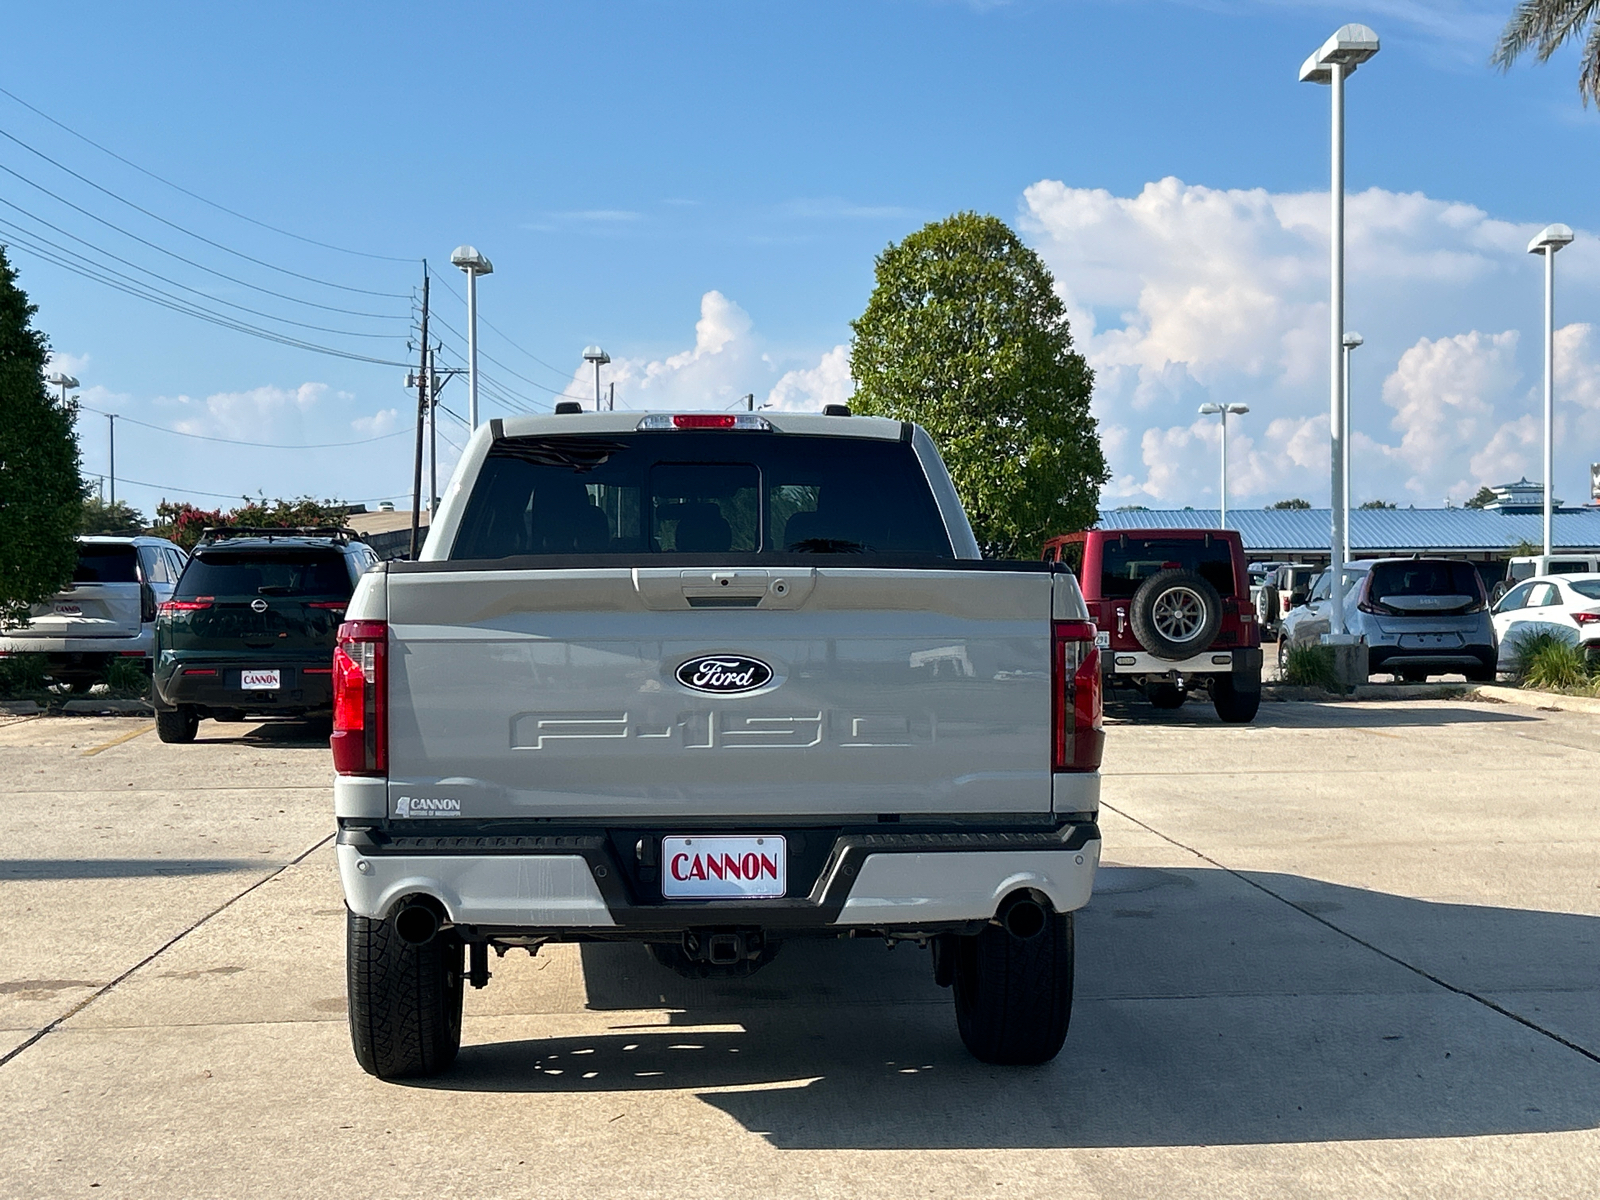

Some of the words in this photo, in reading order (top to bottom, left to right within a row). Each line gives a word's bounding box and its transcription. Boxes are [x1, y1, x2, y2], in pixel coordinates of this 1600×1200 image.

[243, 675, 278, 685] CANNON
[693, 659, 754, 687] Ford
[509, 710, 937, 750] F-150
[410, 798, 461, 811] CANNON
[671, 852, 778, 881] CANNON
